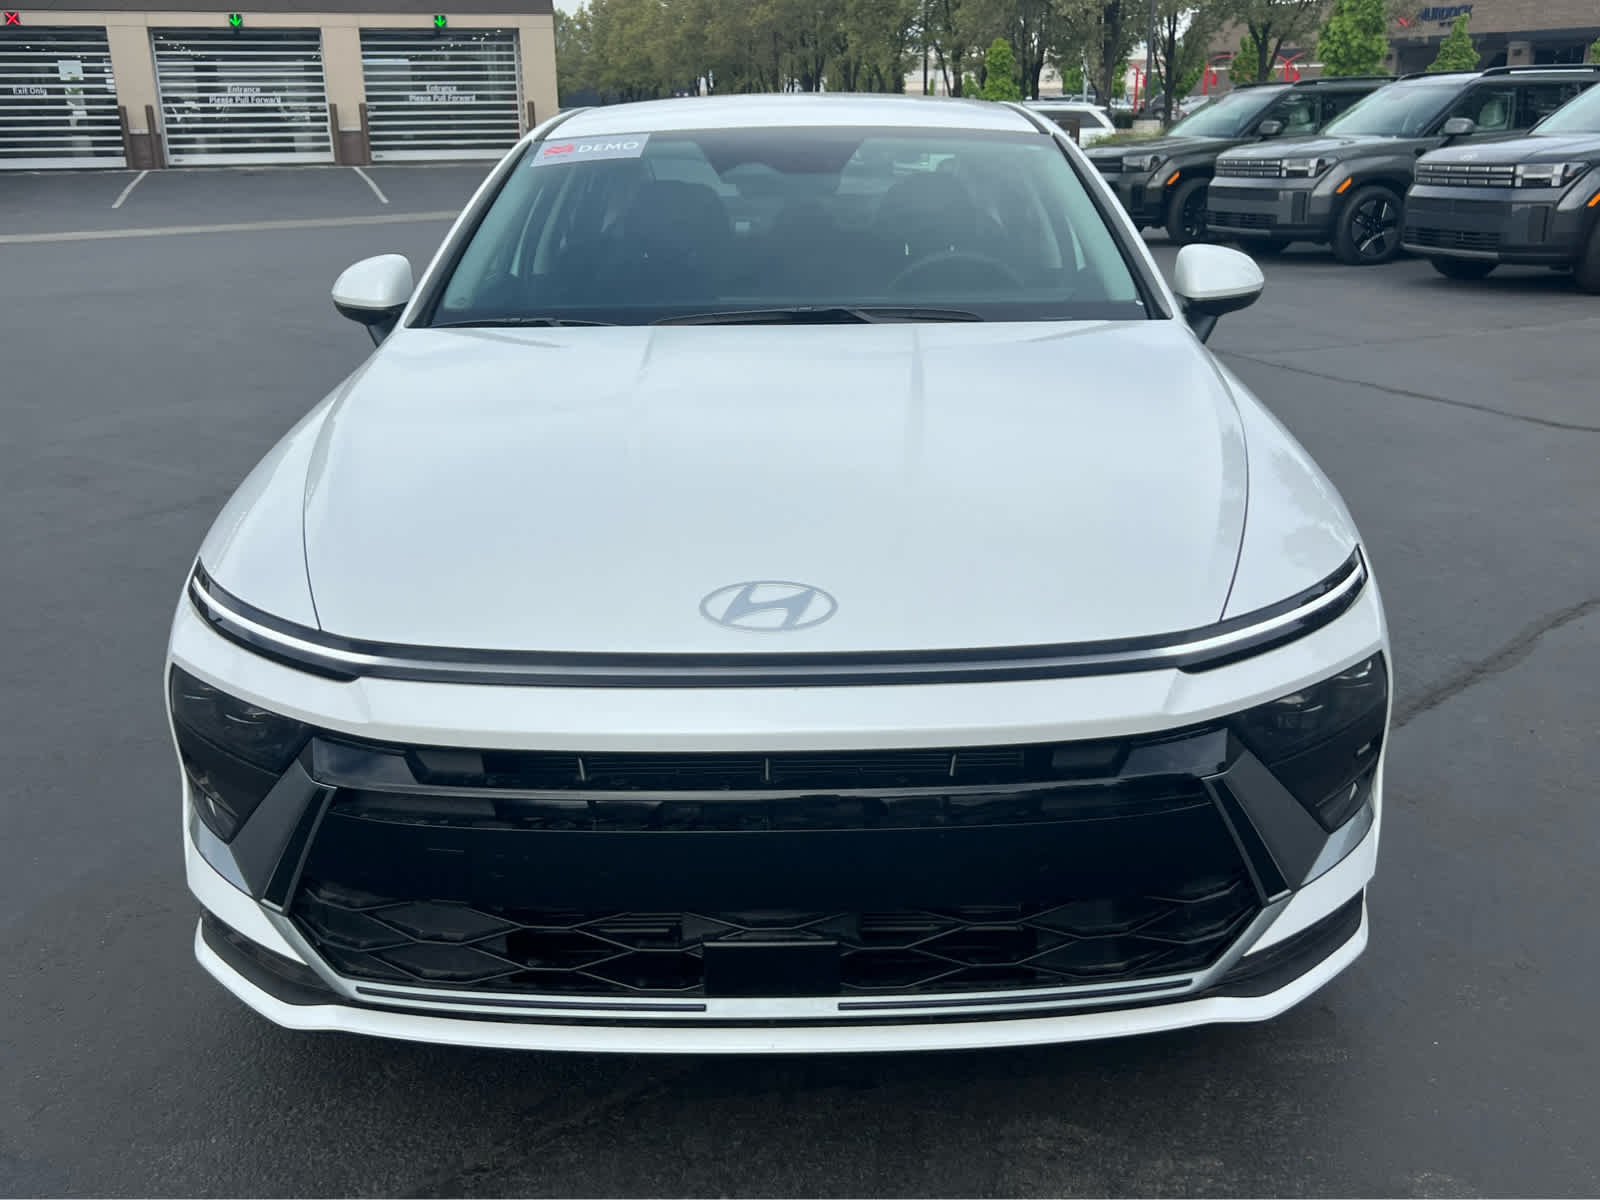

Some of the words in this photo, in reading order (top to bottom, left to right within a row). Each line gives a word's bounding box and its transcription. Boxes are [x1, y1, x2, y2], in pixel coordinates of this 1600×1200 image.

[12, 86, 29, 96] Exit
[30, 86, 48, 97] Only
[227, 84, 260, 95] Entrance
[426, 83, 457, 93] Entrance
[209, 95, 233, 105] Please
[235, 95, 249, 105] Pull
[250, 95, 281, 105] Forward
[409, 94, 431, 104] Please
[432, 94, 447, 103] Pull
[448, 93, 476, 103] Forward
[578, 141, 640, 153] DEMO
